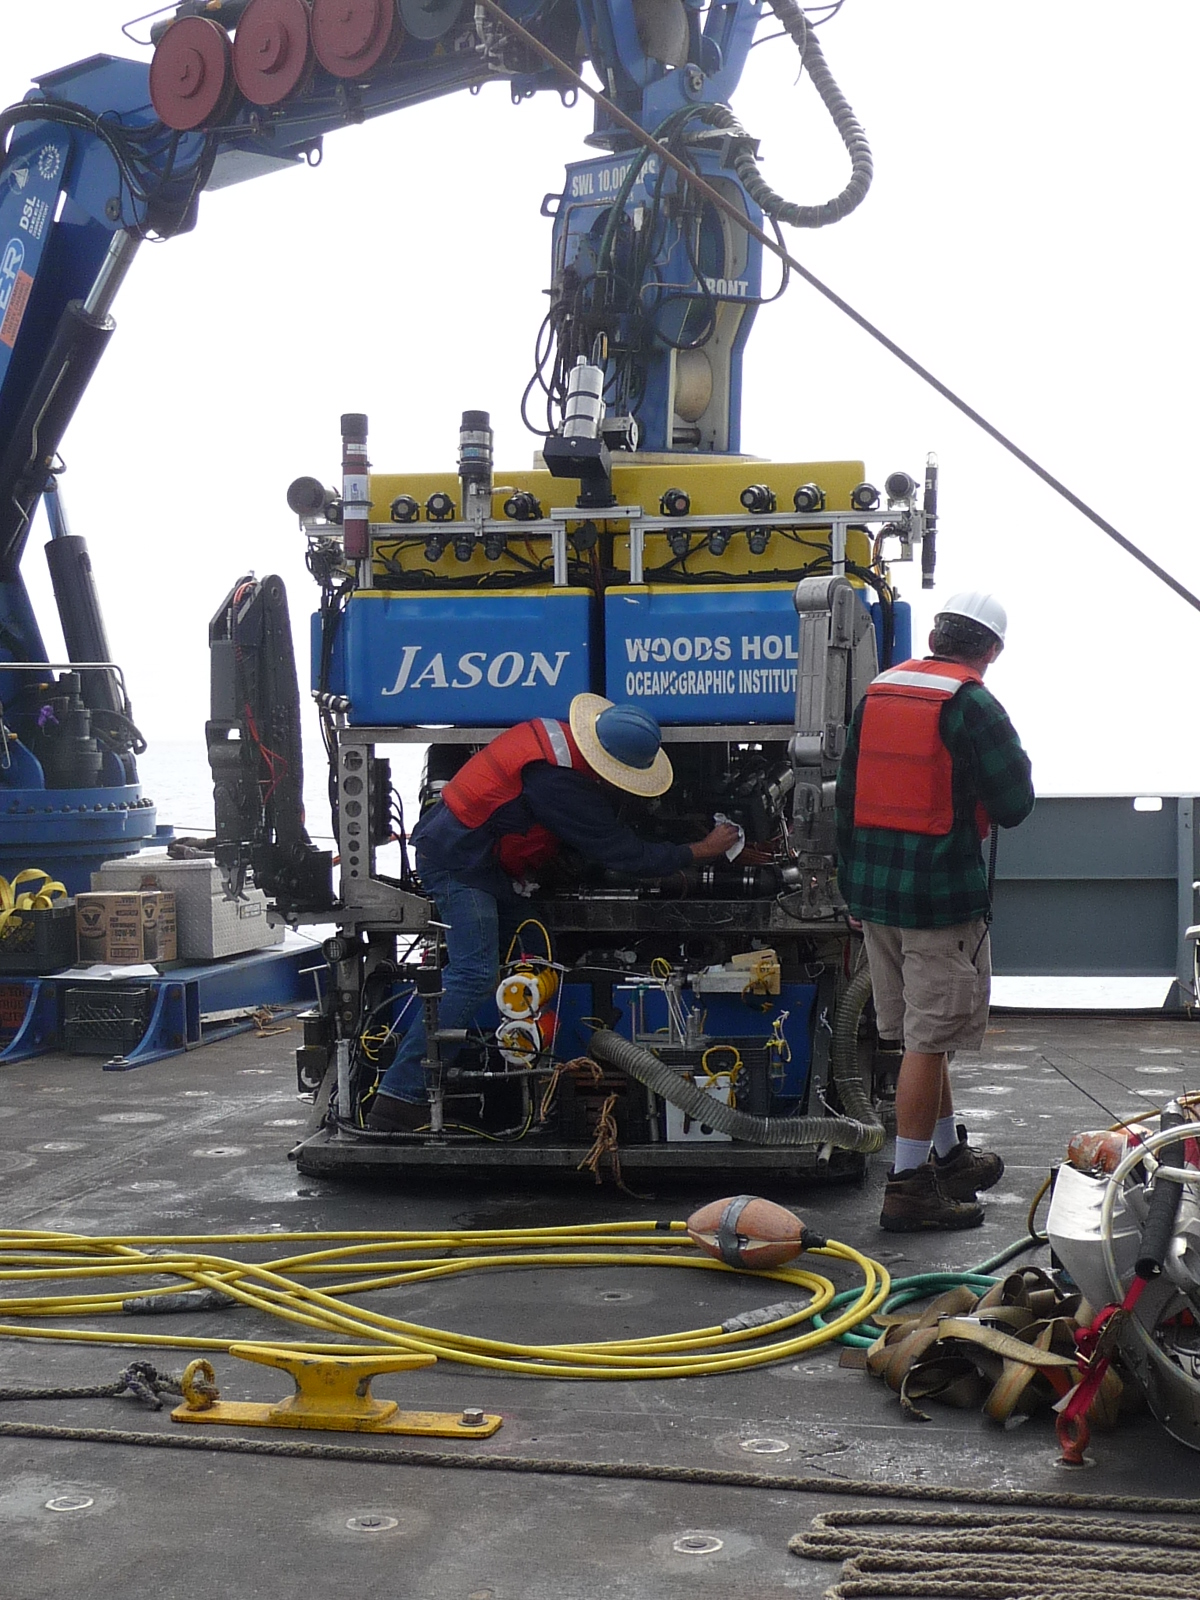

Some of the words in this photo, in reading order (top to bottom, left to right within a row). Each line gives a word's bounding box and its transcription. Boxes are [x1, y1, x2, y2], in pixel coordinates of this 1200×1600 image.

[572, 173, 594, 198] SWL
[598, 163, 633, 192] 10,00
[19, 196, 36, 230] DSL
[36, 203, 49, 239] LABORATORY
[625, 636, 731, 662] WOODS
[381, 646, 570, 695] JASON
[626, 670, 735, 695] OCEANOGRAPHIC
